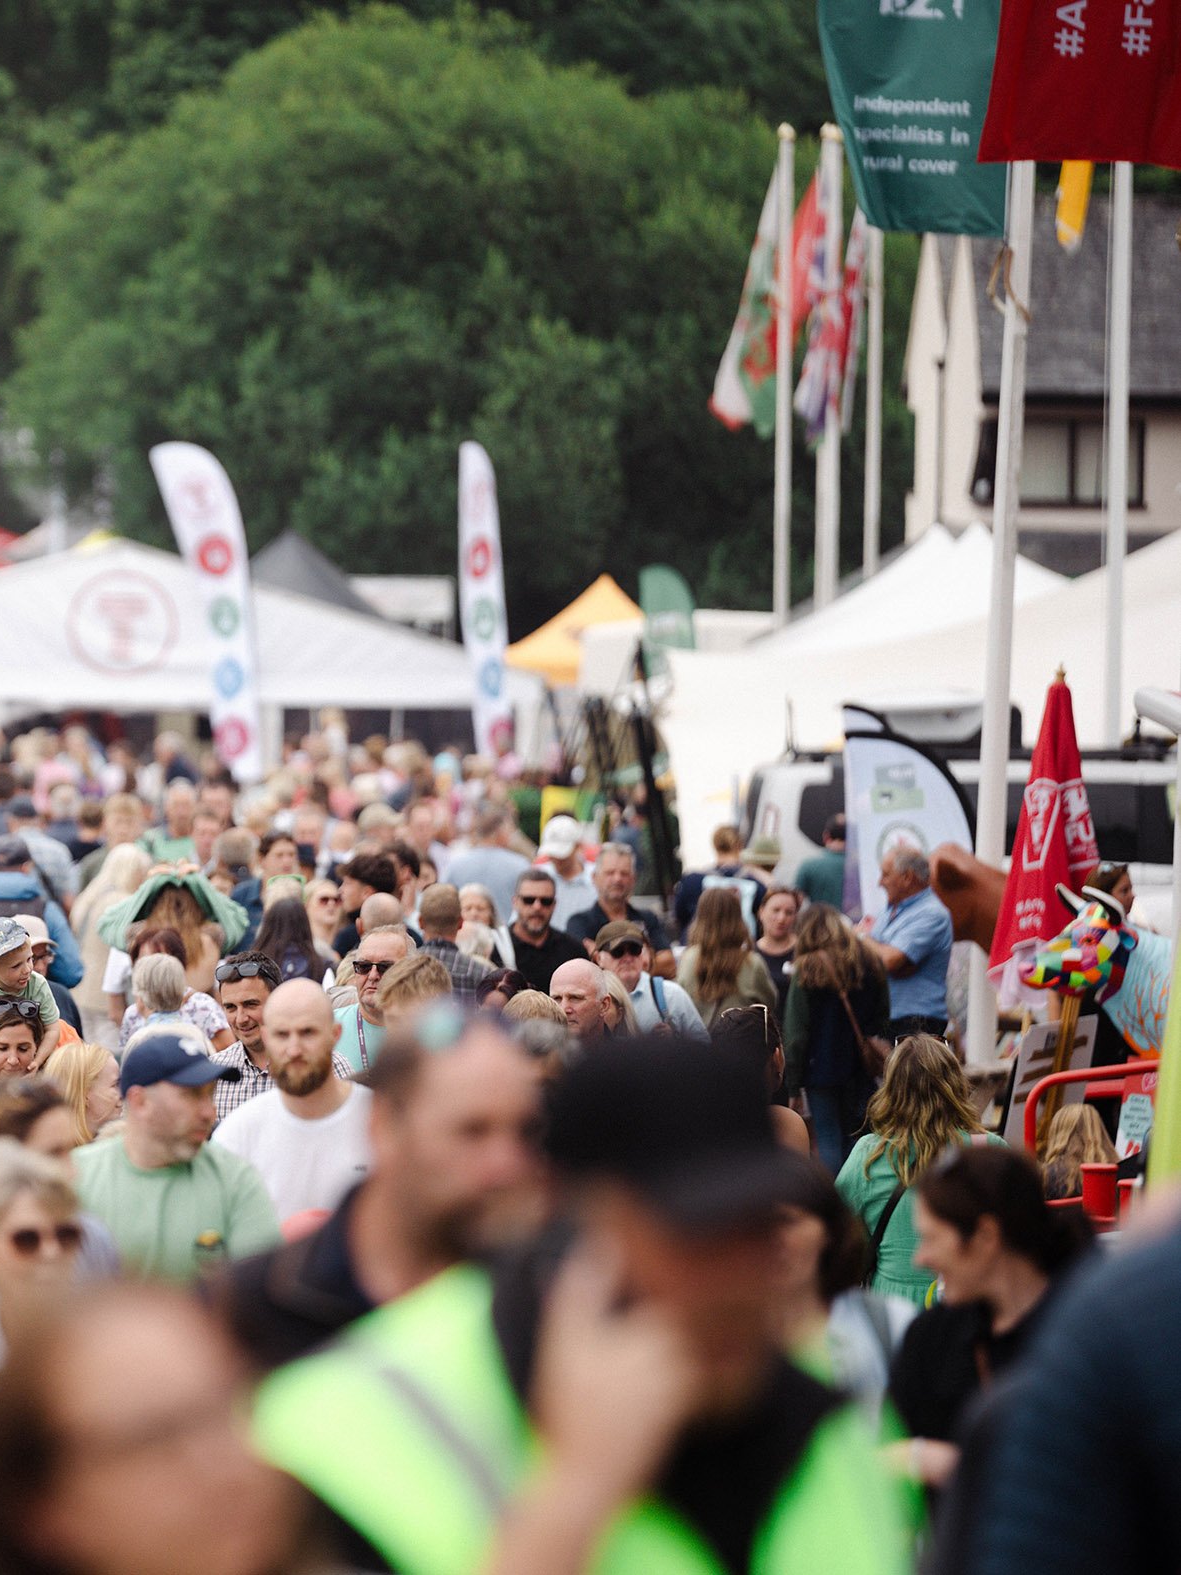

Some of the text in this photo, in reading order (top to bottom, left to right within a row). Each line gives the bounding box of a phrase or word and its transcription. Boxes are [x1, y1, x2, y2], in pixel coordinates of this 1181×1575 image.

[854, 95, 971, 117] Independent
[950, 126, 970, 146] in
[862, 154, 958, 174] rural cover
